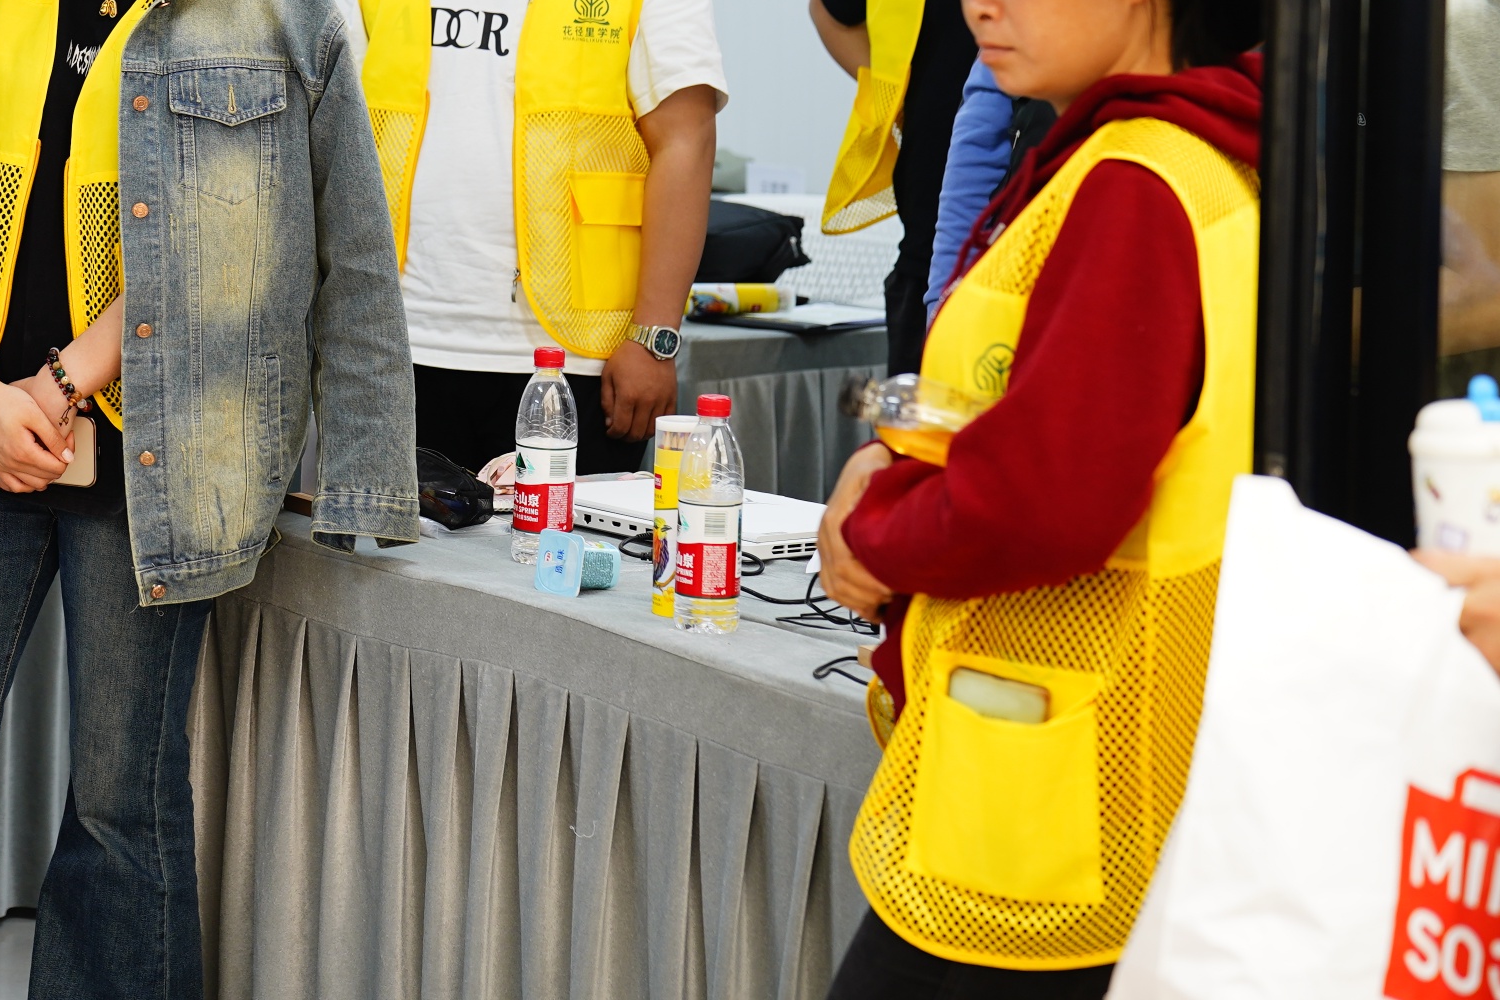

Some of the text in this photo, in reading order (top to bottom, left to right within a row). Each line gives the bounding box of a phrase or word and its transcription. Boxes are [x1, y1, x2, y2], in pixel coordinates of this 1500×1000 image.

[563, 25, 620, 40] 花径里学院
[519, 505, 539, 516] SPRING
[1409, 817, 1500, 918] MI
